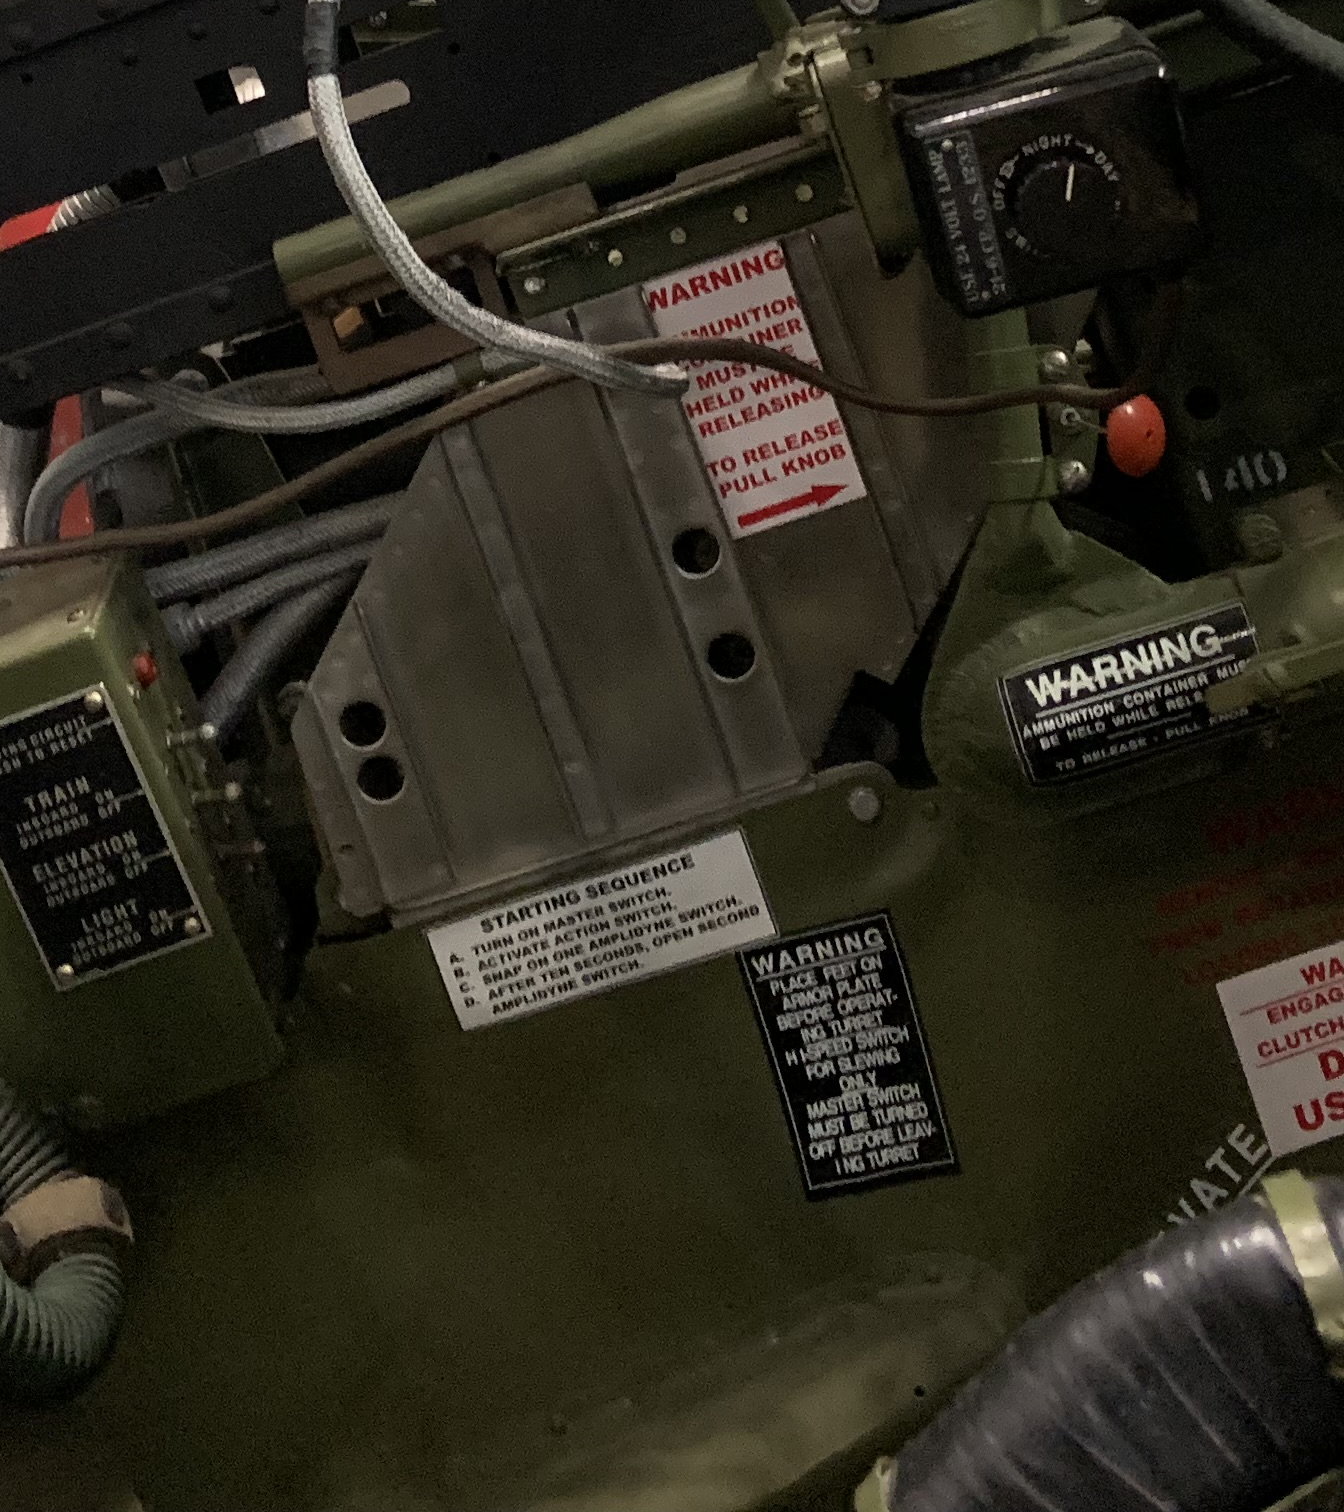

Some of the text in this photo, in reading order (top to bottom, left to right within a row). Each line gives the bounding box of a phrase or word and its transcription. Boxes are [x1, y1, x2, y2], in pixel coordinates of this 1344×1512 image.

[1021, 132, 1073, 157] NIGHT
[647, 249, 785, 313] WARNING
[684, 386, 745, 418] HELD
[698, 385, 825, 437] RELEASING
[707, 418, 844, 477] TO RELEASE
[718, 443, 847, 499] PULL KNOB
[1025, 624, 1223, 708] WARNING
[1023, 658, 1251, 738] AMMUNITION CONTAINER MUS
[1040, 733, 1060, 751] BE
[1066, 720, 1106, 742] HELD
[1112, 705, 1159, 728] WHILE
[1165, 721, 1201, 740] PULL
[24, 775, 90, 813] TRAIN
[95, 789, 114, 805] ON
[98, 799, 121, 820] OFF
[32, 829, 138, 883] ELEVATION
[122, 850, 141, 866] ON
[125, 862, 148, 880] OFF
[480, 852, 696, 934] STARTING SEQUENCE
[81, 898, 139, 934] LIGHT
[149, 909, 167, 925] ON
[151, 920, 173, 937] OFF
[450, 886, 673, 966] A. TURN ON MASTER SWITCH.
[459, 894, 744, 994] C. SNAP ON ONE AMPLIDYNE SWITCH.
[478, 938, 551, 973] ACTIVATE
[554, 919, 611, 946] ACTION
[614, 900, 678, 928] SWITCH.
[488, 975, 536, 1001] AFTER
[540, 964, 570, 983] TEN
[652, 925, 694, 948] OPEN
[697, 903, 760, 935] SECOND
[751, 927, 885, 976] WARNING
[770, 952, 883, 997] PLACE FEET ON
[783, 972, 883, 1011] ARMOR PLATE
[492, 977, 578, 1016] AMPLIDYNE
[776, 988, 898, 1032] BEFORE OPERAT-
[800, 1009, 883, 1045] ING TURRET
[855, 1025, 910, 1051] SWITCH
[806, 1046, 901, 1081] FOR SLEWING
[839, 1069, 877, 1092] ONLY
[806, 1082, 921, 1120] MASTER SWITCH
[808, 1101, 929, 1139] MUST BE TURNED
[809, 1120, 937, 1161] OFF BEFORE LEAV-
[866, 1142, 920, 1170] TURRET
[1163, 1122, 1270, 1230] VATE
